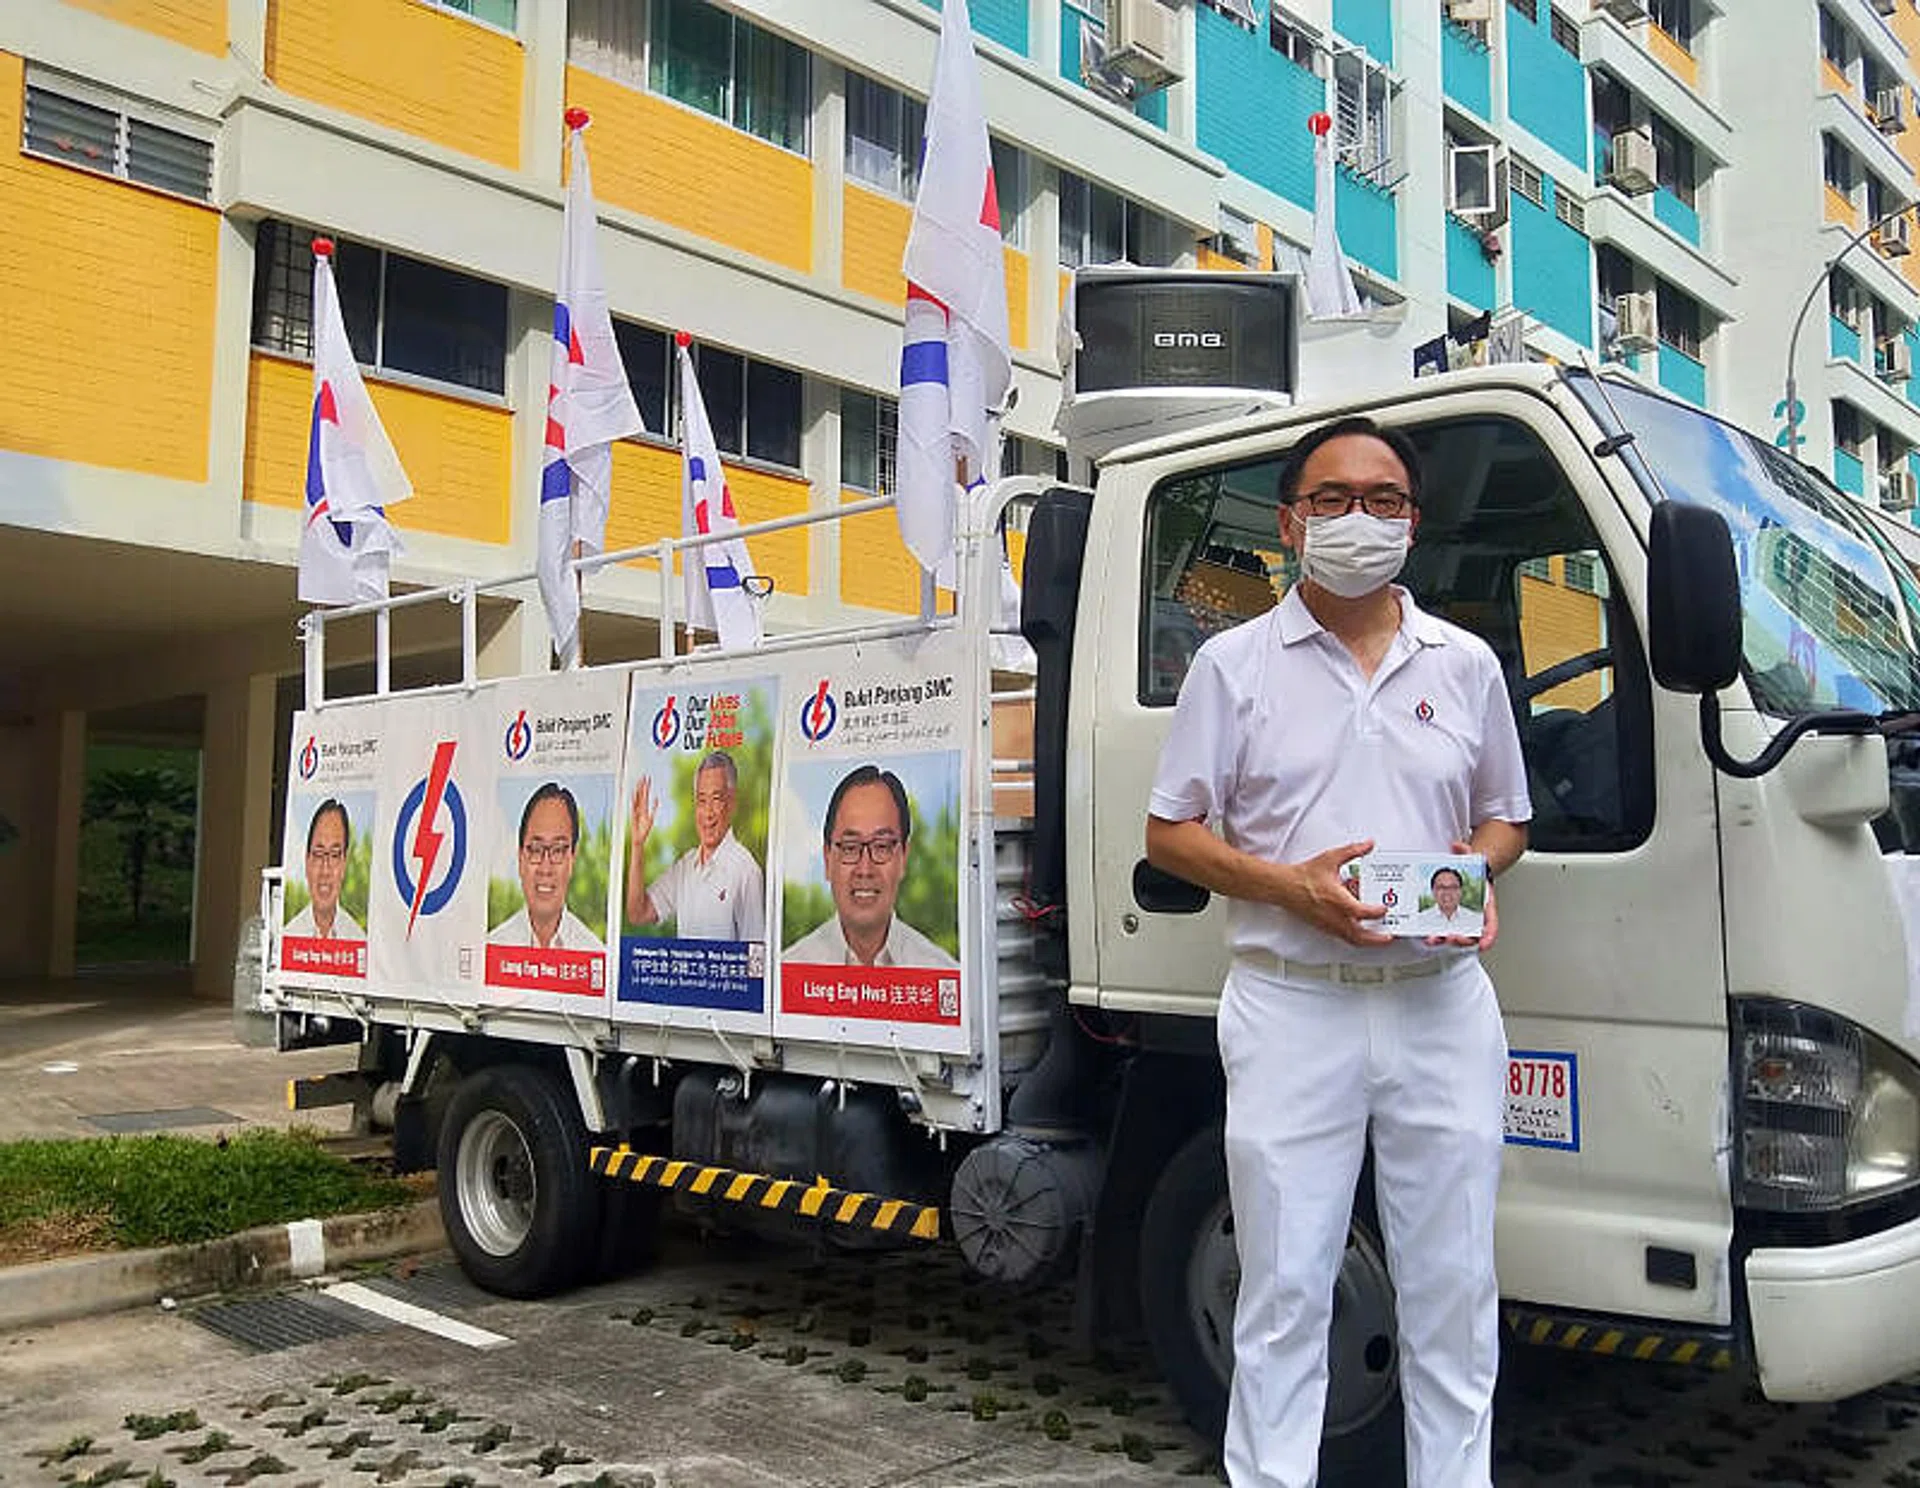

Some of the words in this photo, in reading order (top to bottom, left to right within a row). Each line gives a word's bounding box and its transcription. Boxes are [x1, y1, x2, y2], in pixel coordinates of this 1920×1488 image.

[1774, 400, 1806, 447] 2
[687, 696, 709, 712] Our
[710, 692, 741, 711] Lives
[845, 689, 873, 708] Bukit
[874, 685, 922, 707] Panjang
[924, 676, 954, 700] SMC
[685, 714, 706, 731] Our
[683, 732, 704, 750] Our
[804, 981, 835, 1003] Liang
[838, 983, 858, 1005] Eng
[862, 984, 888, 1002] Hwa
[1504, 1061, 1566, 1099] 8778
